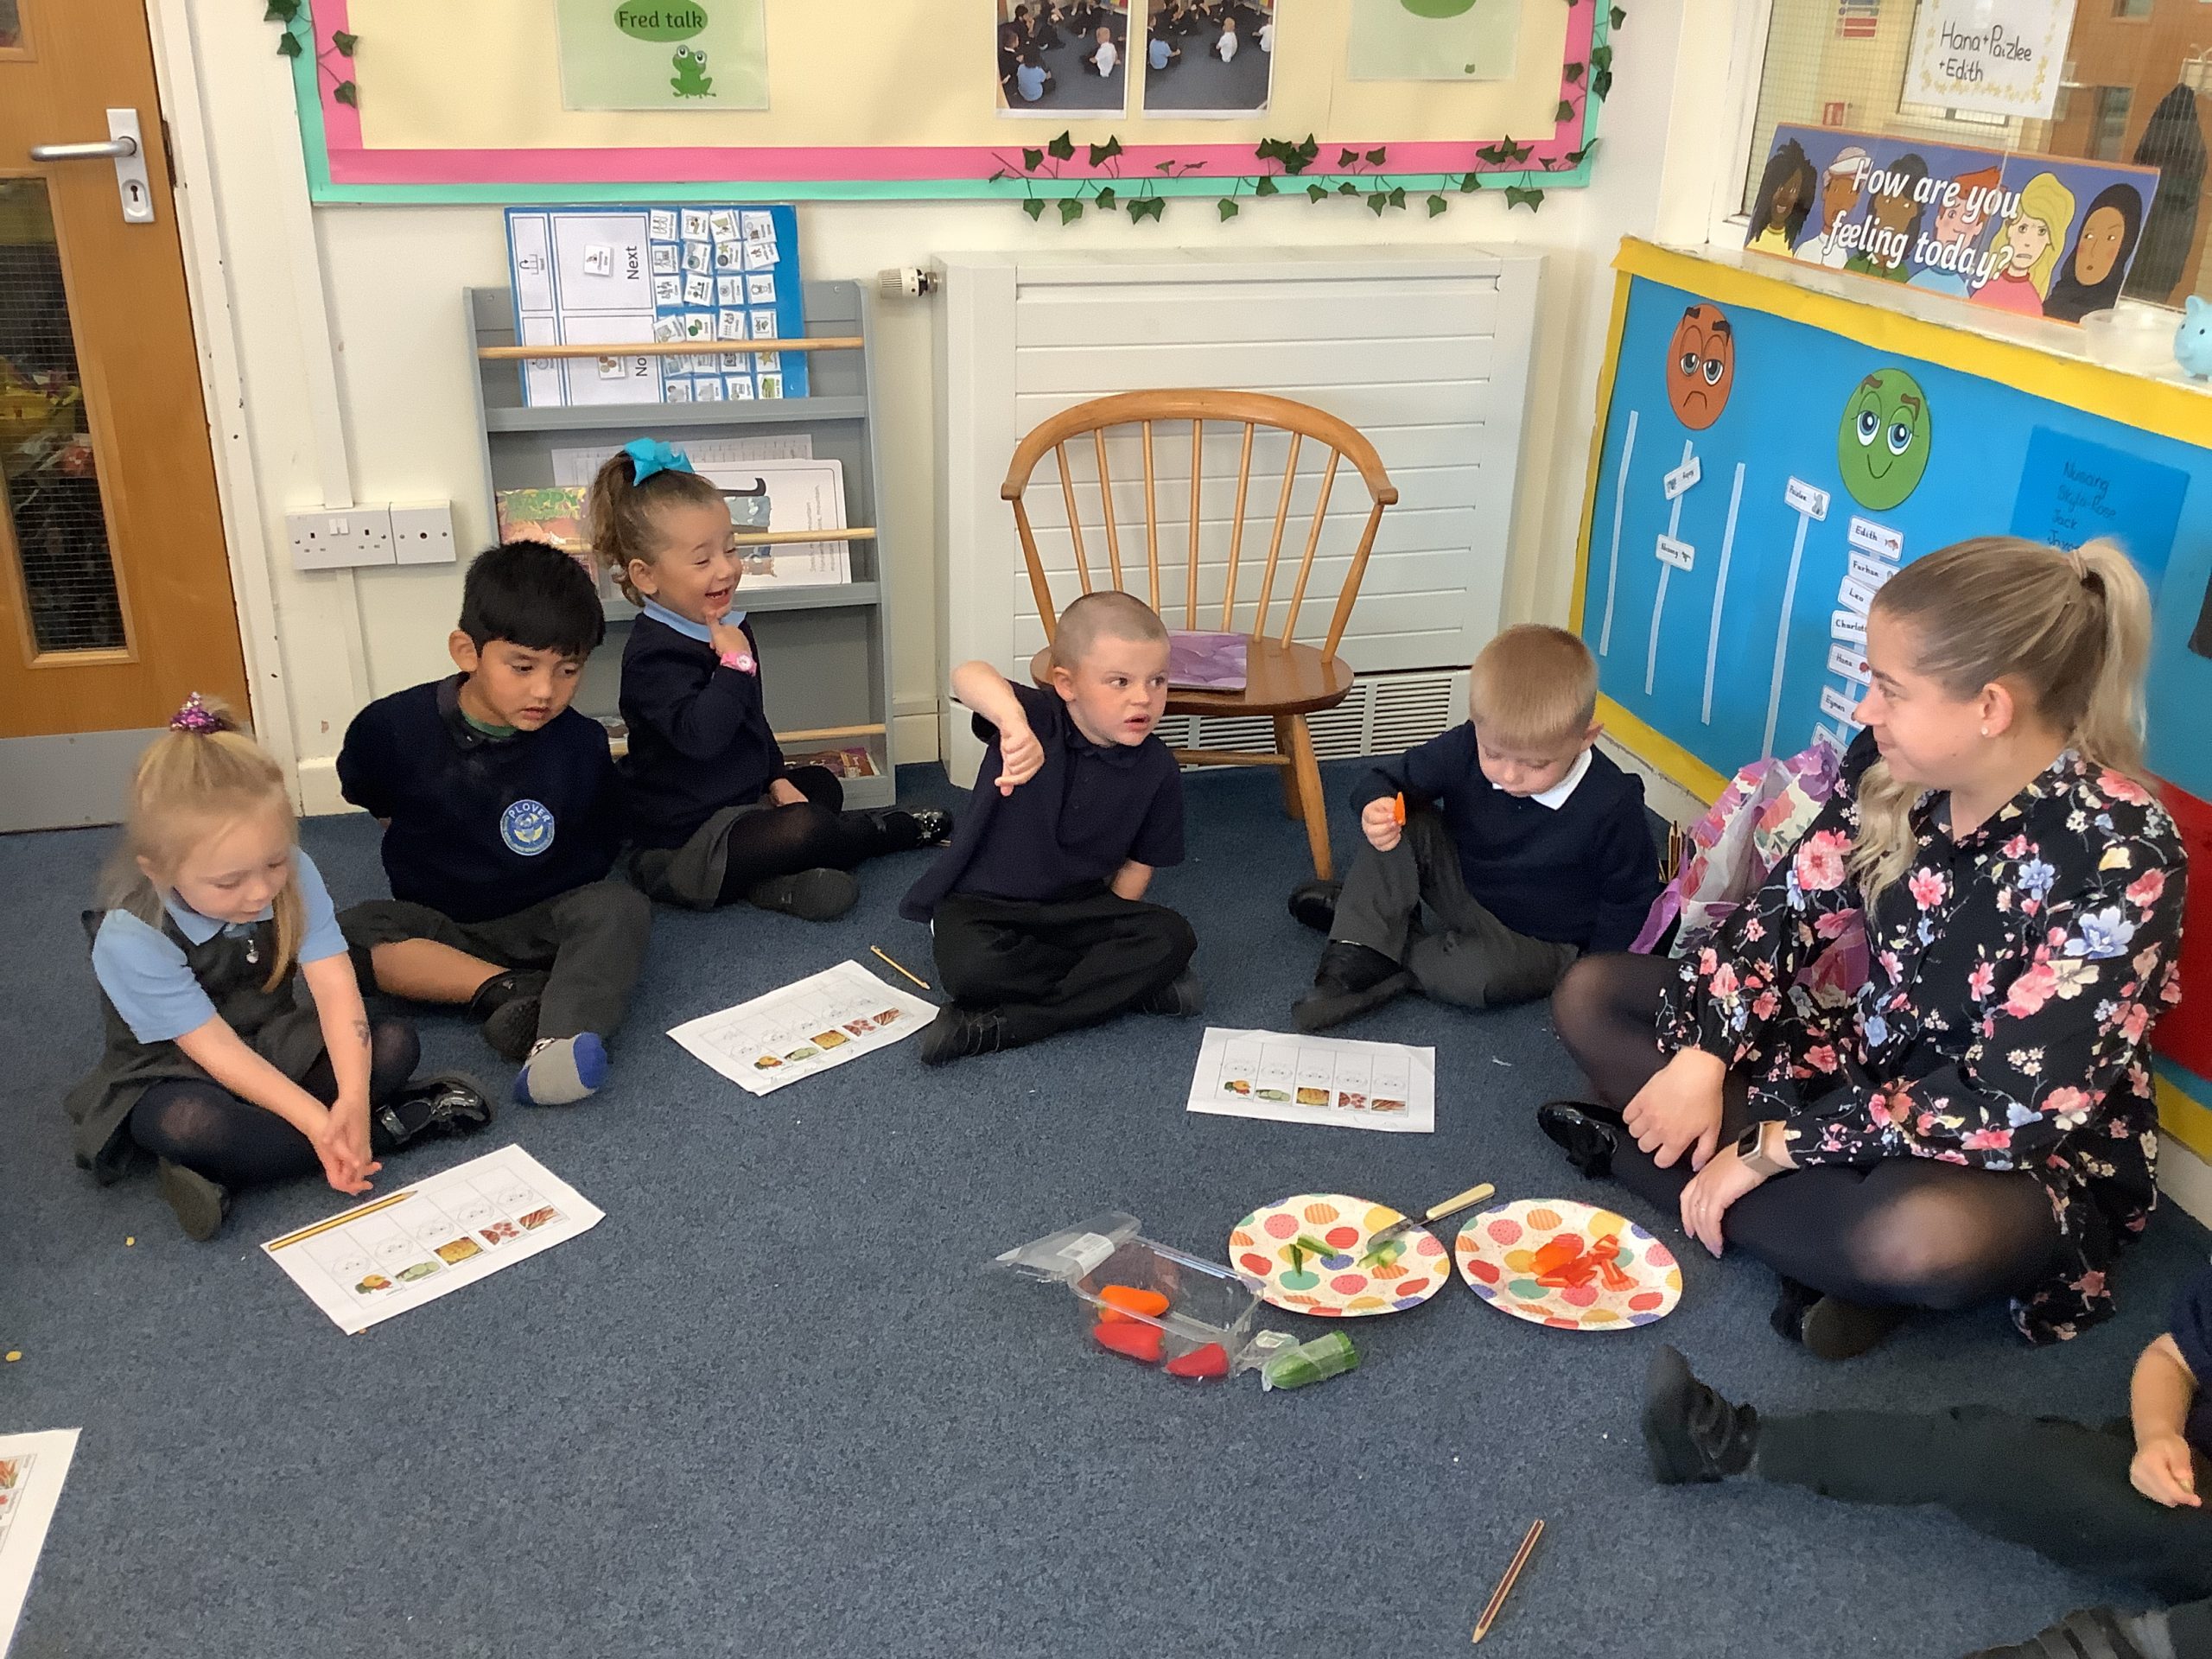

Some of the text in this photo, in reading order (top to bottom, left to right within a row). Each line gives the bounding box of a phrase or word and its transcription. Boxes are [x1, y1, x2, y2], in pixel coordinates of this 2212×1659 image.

[619, 10, 703, 29] Fred talk
[1853, 157, 2023, 224] How are you
[1822, 211, 2013, 289] feeling today?
[626, 245, 639, 280] Next
[635, 355, 647, 377] No
[2052, 509, 2078, 530] Jack
[1855, 525, 1878, 542] Edith
[1853, 560, 1878, 577] Farhan
[1849, 587, 1864, 602] Leo
[1836, 653, 1853, 667] Hana
[508, 803, 550, 822] PLOVER
